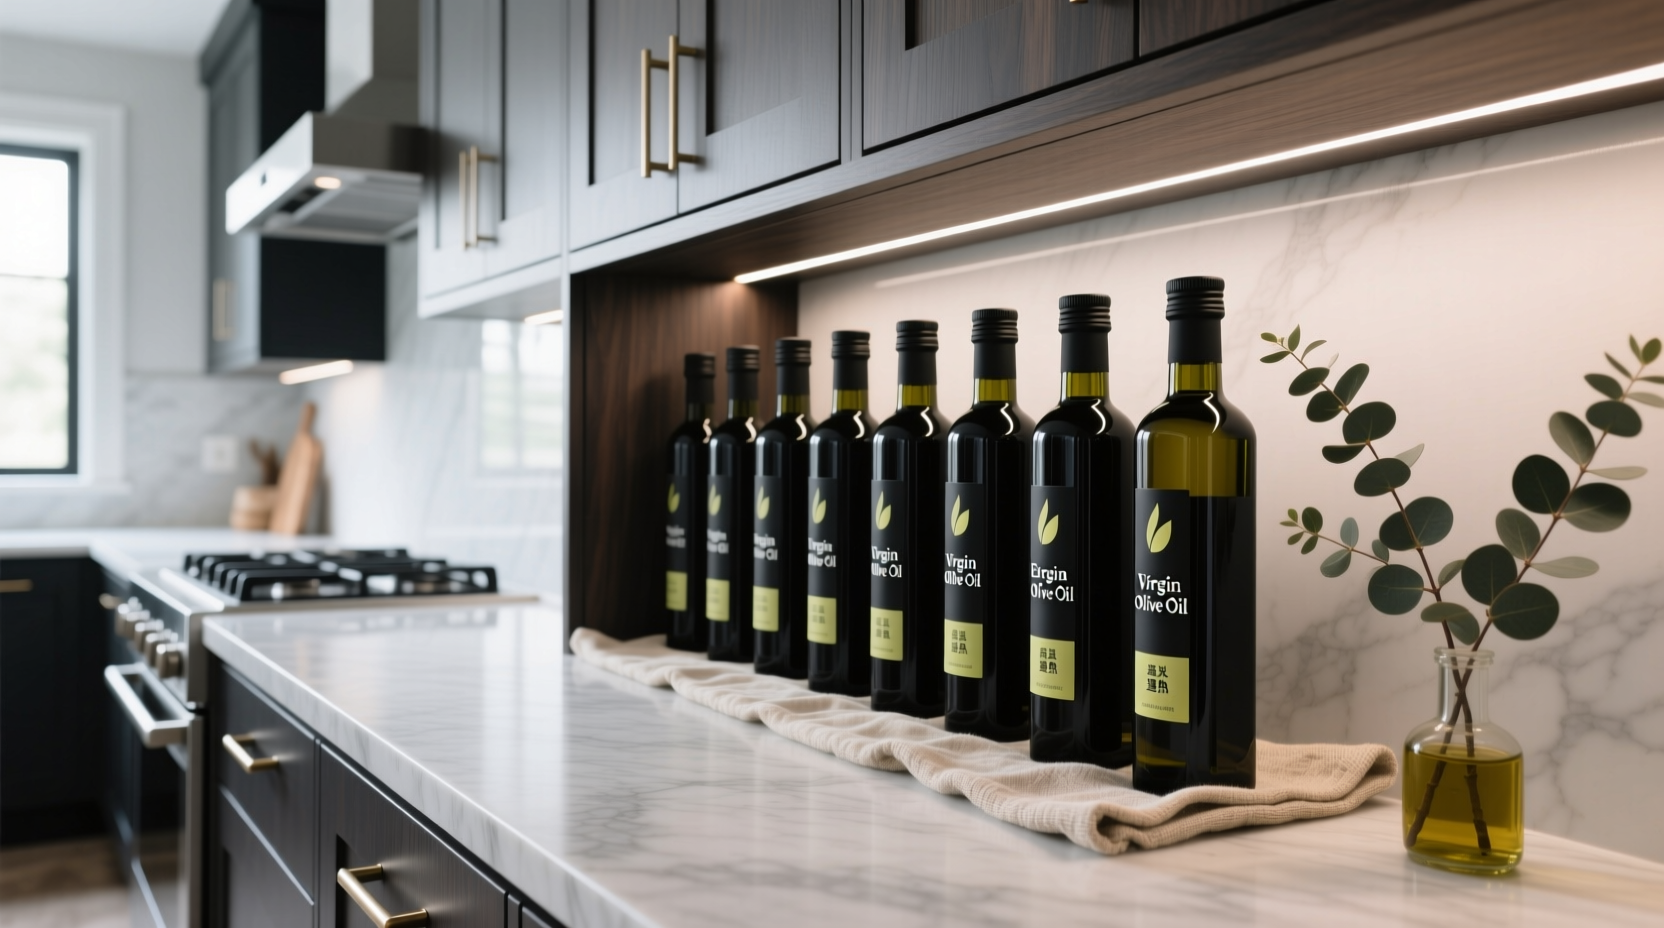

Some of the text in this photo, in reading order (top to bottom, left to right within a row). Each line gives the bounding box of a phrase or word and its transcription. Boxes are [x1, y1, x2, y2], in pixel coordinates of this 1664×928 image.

[1055, 585, 1074, 601] Oil
[1135, 595, 1188, 614] Olive Oil
